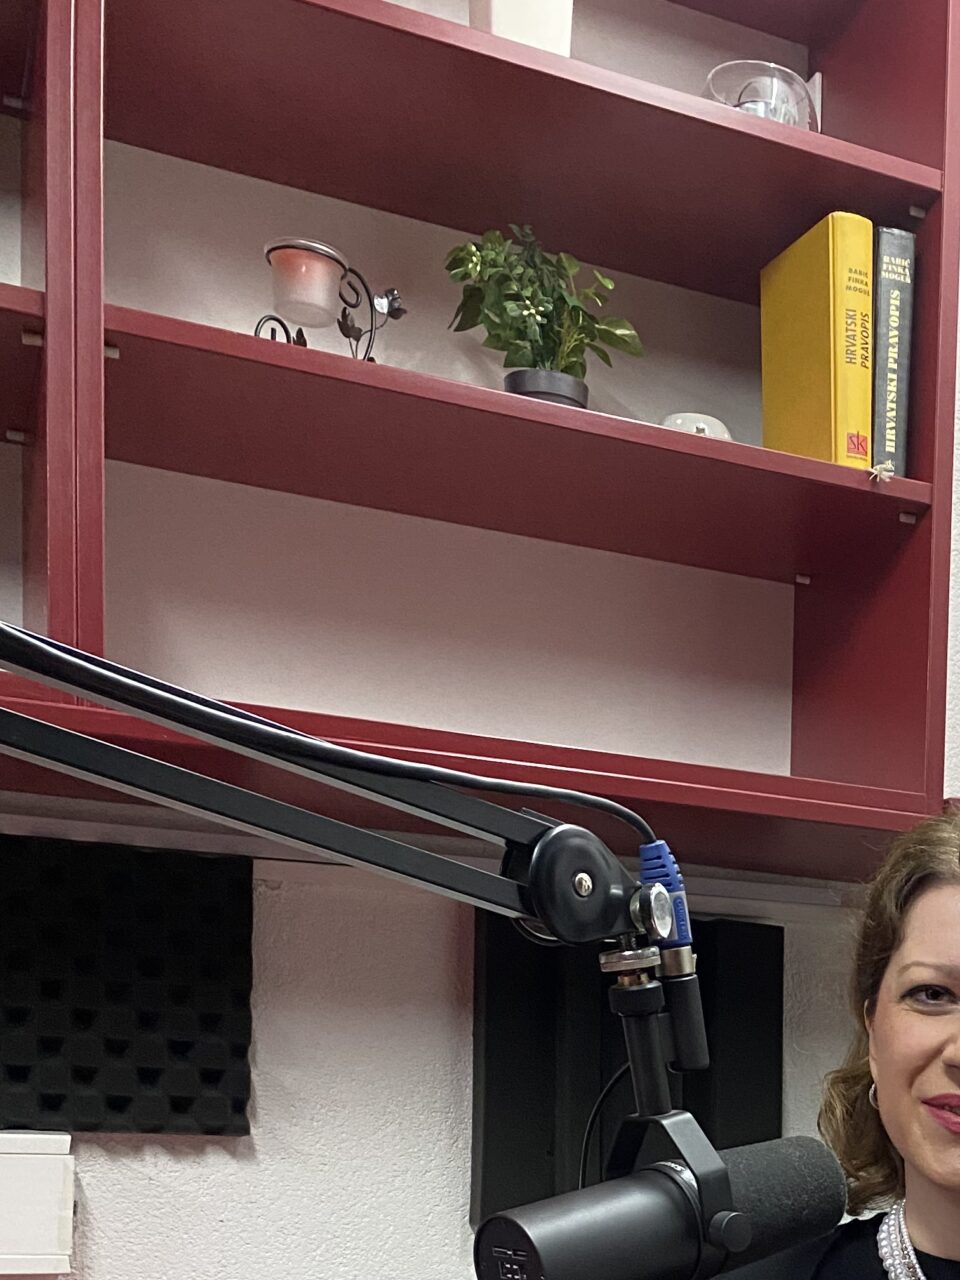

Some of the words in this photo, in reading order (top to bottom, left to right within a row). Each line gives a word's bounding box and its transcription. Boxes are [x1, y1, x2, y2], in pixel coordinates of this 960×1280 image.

[848, 276, 868, 287] FINKA
[883, 263, 909, 276] FINKA
[845, 308, 857, 365] HRVATSKI
[860, 312, 870, 369] PRAVOPIS
[888, 289, 900, 370] PRAVOPIS
[885, 372, 898, 453] HRVATSKI
